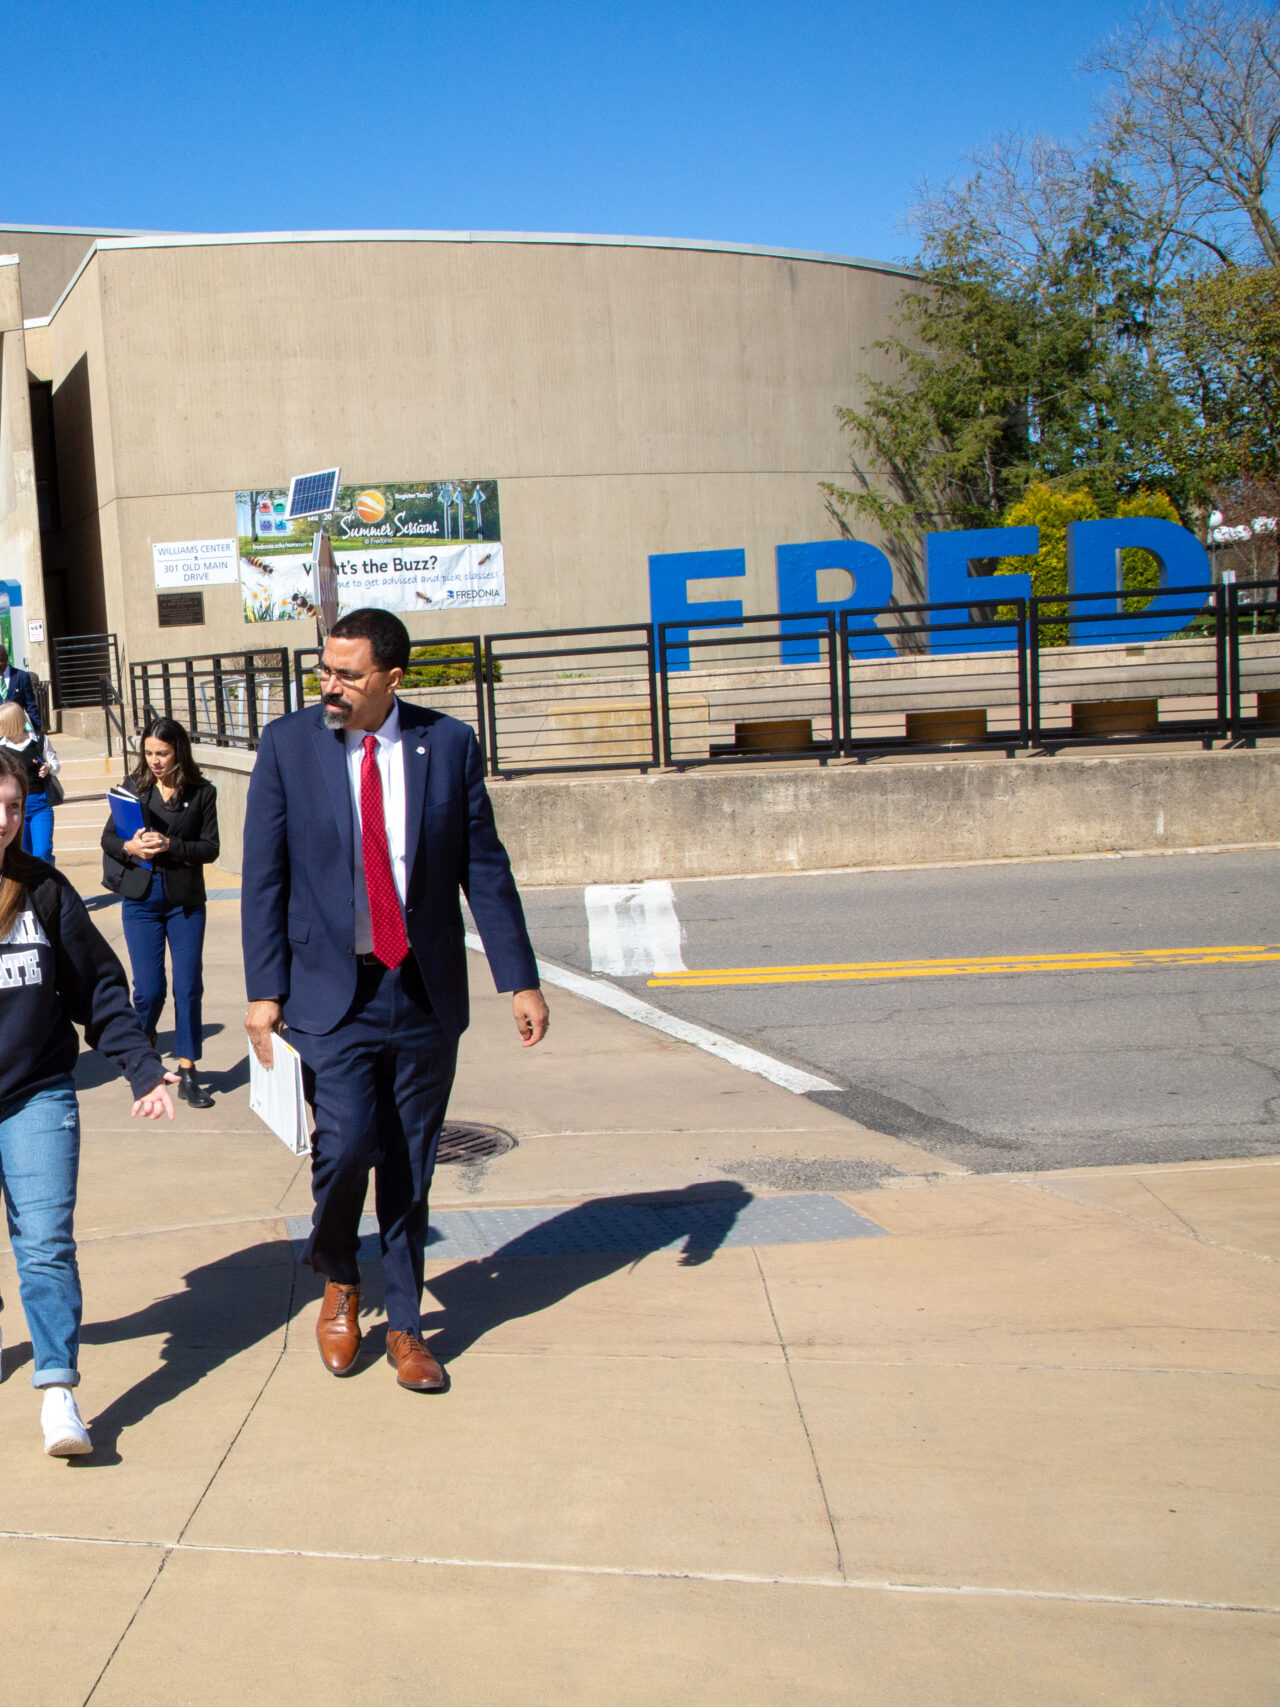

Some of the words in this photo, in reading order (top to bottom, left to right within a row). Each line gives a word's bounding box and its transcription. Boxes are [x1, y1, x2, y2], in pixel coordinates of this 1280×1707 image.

[340, 512, 393, 540] Summer
[394, 510, 440, 537] Sessions
[157, 545, 199, 556] WILLIAMS
[200, 543, 231, 553] CENTER
[163, 564, 179, 573] 301
[182, 563, 201, 572] OLD
[203, 561, 228, 570] MAIN
[361, 558, 388, 574] the
[393, 555, 438, 572] Buzz?
[183, 572, 209, 582] DRIVE
[352, 579, 362, 588] to
[364, 578, 379, 590] get
[382, 574, 418, 585] advised
[421, 573, 440, 583] and
[442, 571, 461, 585] pick
[464, 570, 498, 580] classes!
[455, 588, 501, 600] FREDONIA
[648, 516, 1211, 673] FRED
